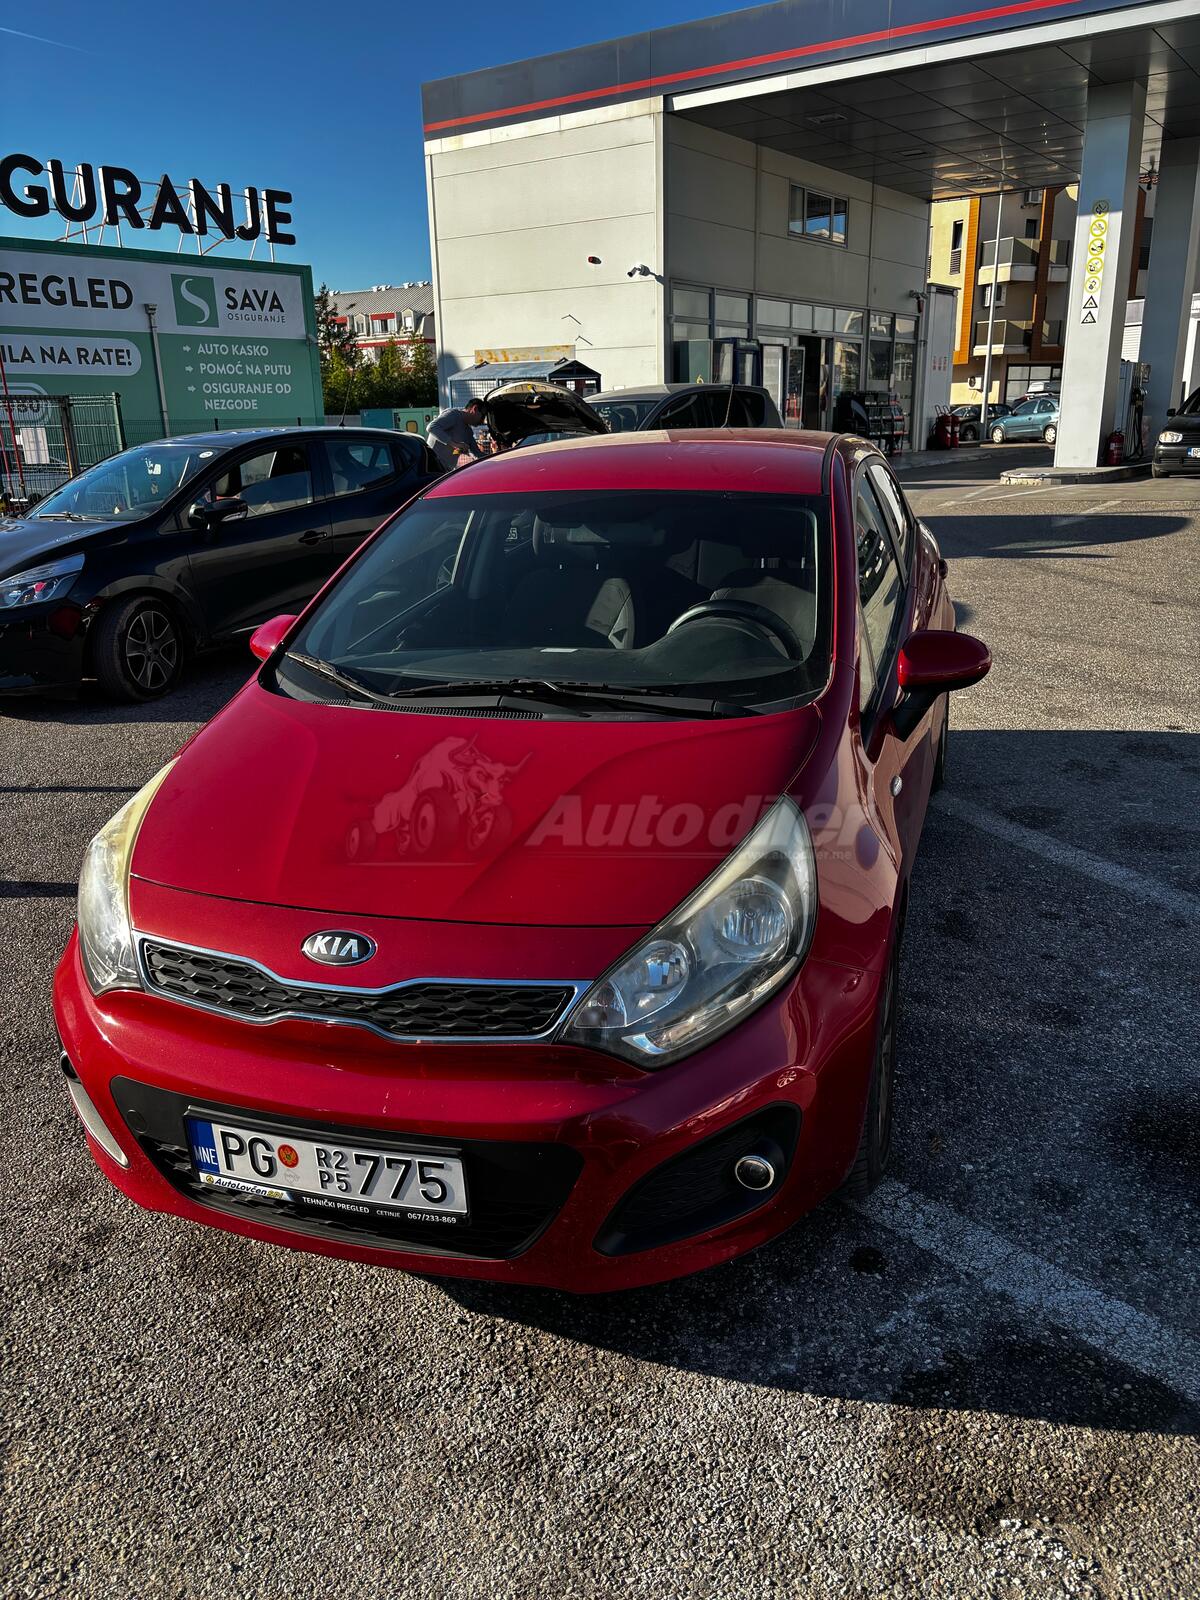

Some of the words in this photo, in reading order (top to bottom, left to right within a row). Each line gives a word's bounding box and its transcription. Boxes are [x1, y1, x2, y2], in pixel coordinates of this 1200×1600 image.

[0, 154, 296, 245] GURANJE
[0, 272, 133, 309] REGLED
[225, 287, 285, 312] SAVA
[227, 313, 286, 323] OSIGURANJE
[40, 346, 72, 365] NA
[76, 347, 132, 366] RATE!
[197, 343, 229, 355] AUTO
[231, 344, 269, 356] KASKO
[200, 360, 243, 375] POMOĆ
[245, 365, 262, 375] NA
[264, 364, 291, 375] PUTU
[202, 382, 273, 394] OSIGURANJE
[275, 383, 292, 394] OD
[204, 399, 258, 410] NEZGODE
[312, 935, 359, 958] KIA
[193, 1145, 218, 1165] MNE
[220, 1131, 275, 1178] PG
[354, 1153, 448, 1203] 775
[302, 1196, 336, 1209] TEHNIČKI
[337, 1202, 370, 1214] PREGLED
[376, 1209, 401, 1218] CETINJE
[407, 1212, 457, 1224] 067/233-869
